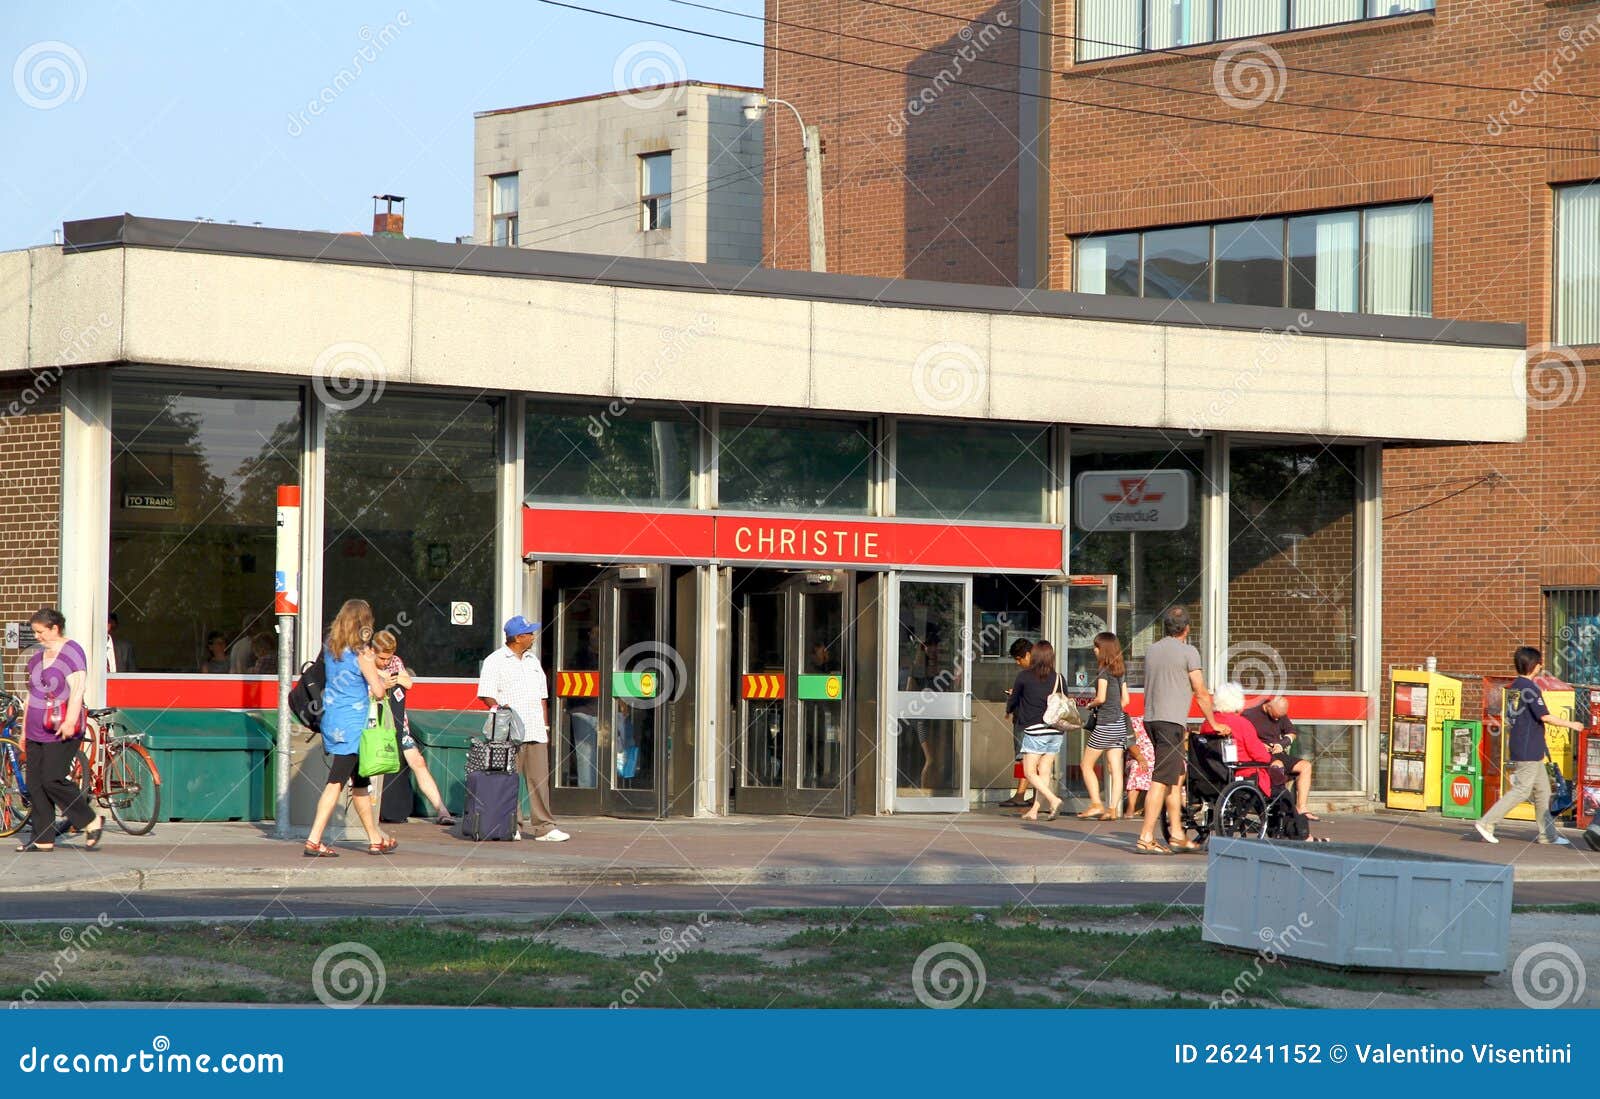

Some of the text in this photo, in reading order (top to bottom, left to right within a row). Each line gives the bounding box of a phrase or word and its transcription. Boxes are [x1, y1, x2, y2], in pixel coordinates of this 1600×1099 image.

[129, 496, 176, 506] TO TRAINS
[735, 526, 879, 558] CHRISTIE
[1453, 783, 1471, 799] NOW
